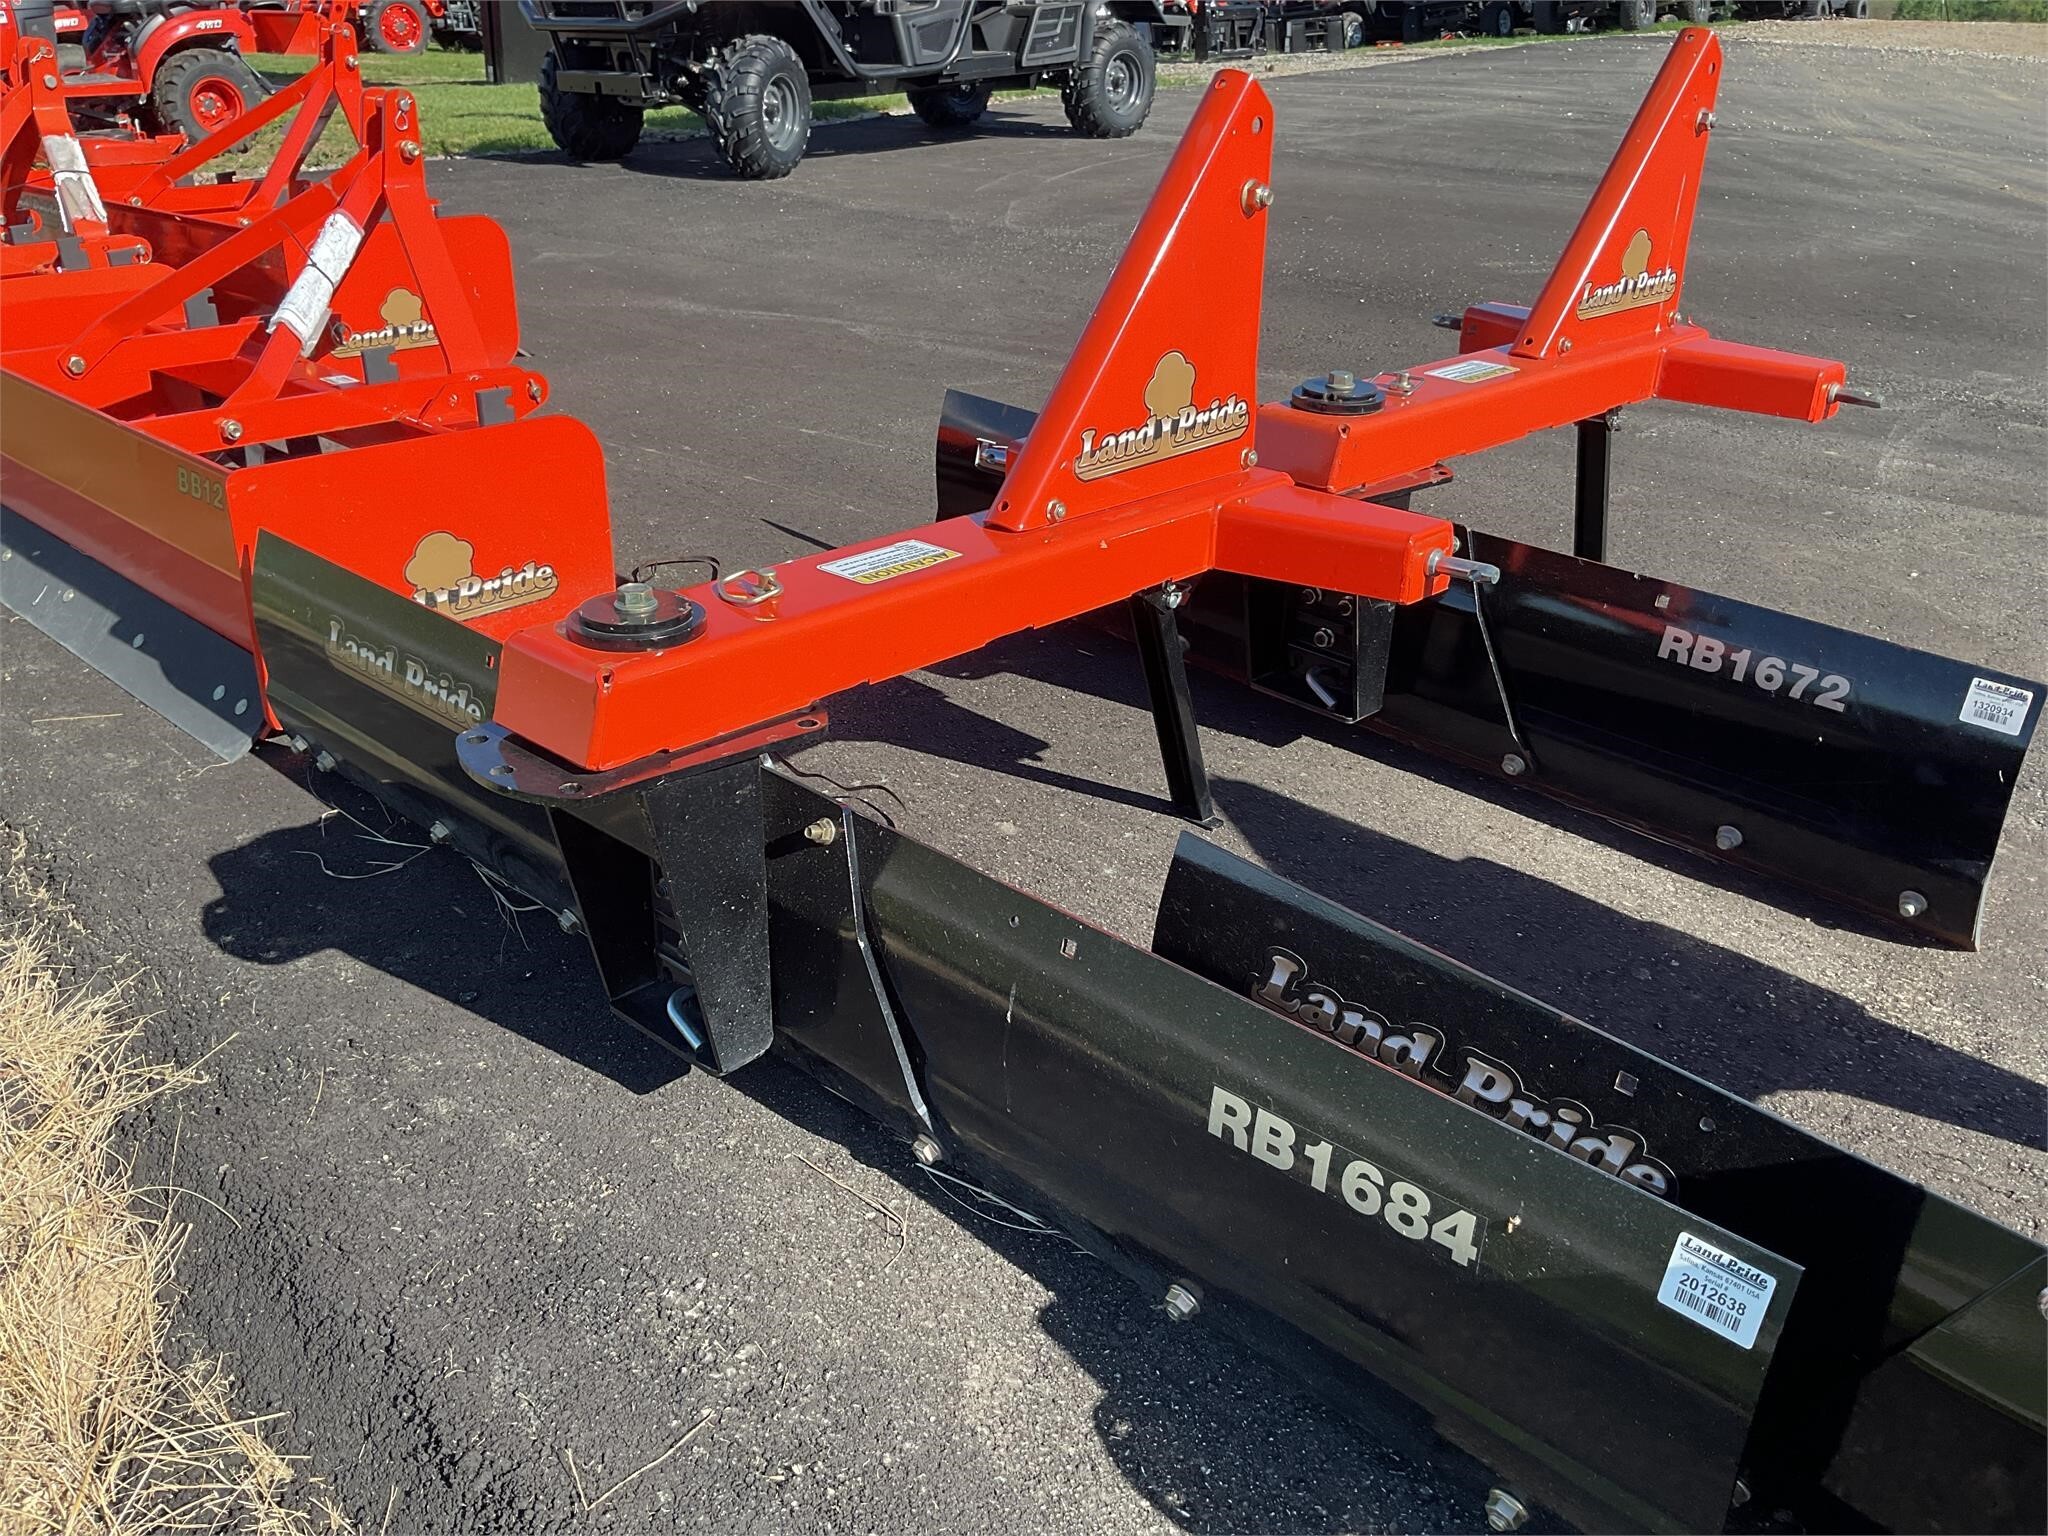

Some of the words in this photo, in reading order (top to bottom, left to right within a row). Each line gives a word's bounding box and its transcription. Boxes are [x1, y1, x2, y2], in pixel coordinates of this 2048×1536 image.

[196, 19, 223, 30] 4WD
[1579, 277, 1625, 310] Land
[1632, 267, 1676, 299] Pride
[1079, 415, 1158, 468] Land
[1174, 394, 1248, 443] Pride
[455, 561, 552, 610] Pride
[327, 620, 395, 685] Land
[404, 660, 481, 725] Pride
[1657, 625, 1850, 712] RB1672
[1974, 680, 2002, 694] Land
[2002, 685, 2029, 702] Pride
[1973, 700, 2013, 717] 1320934
[1252, 955, 1436, 1080] Land
[1207, 1085, 1477, 1267] RB1684
[1681, 1237, 1724, 1264] Land
[1727, 1258, 1768, 1288] Pride
[1701, 1264, 1723, 1282] Kansas
[1746, 1287, 1761, 1300] USA
[1704, 1274, 1724, 1289] Serial
[1680, 1272, 1747, 1316] 2012638
